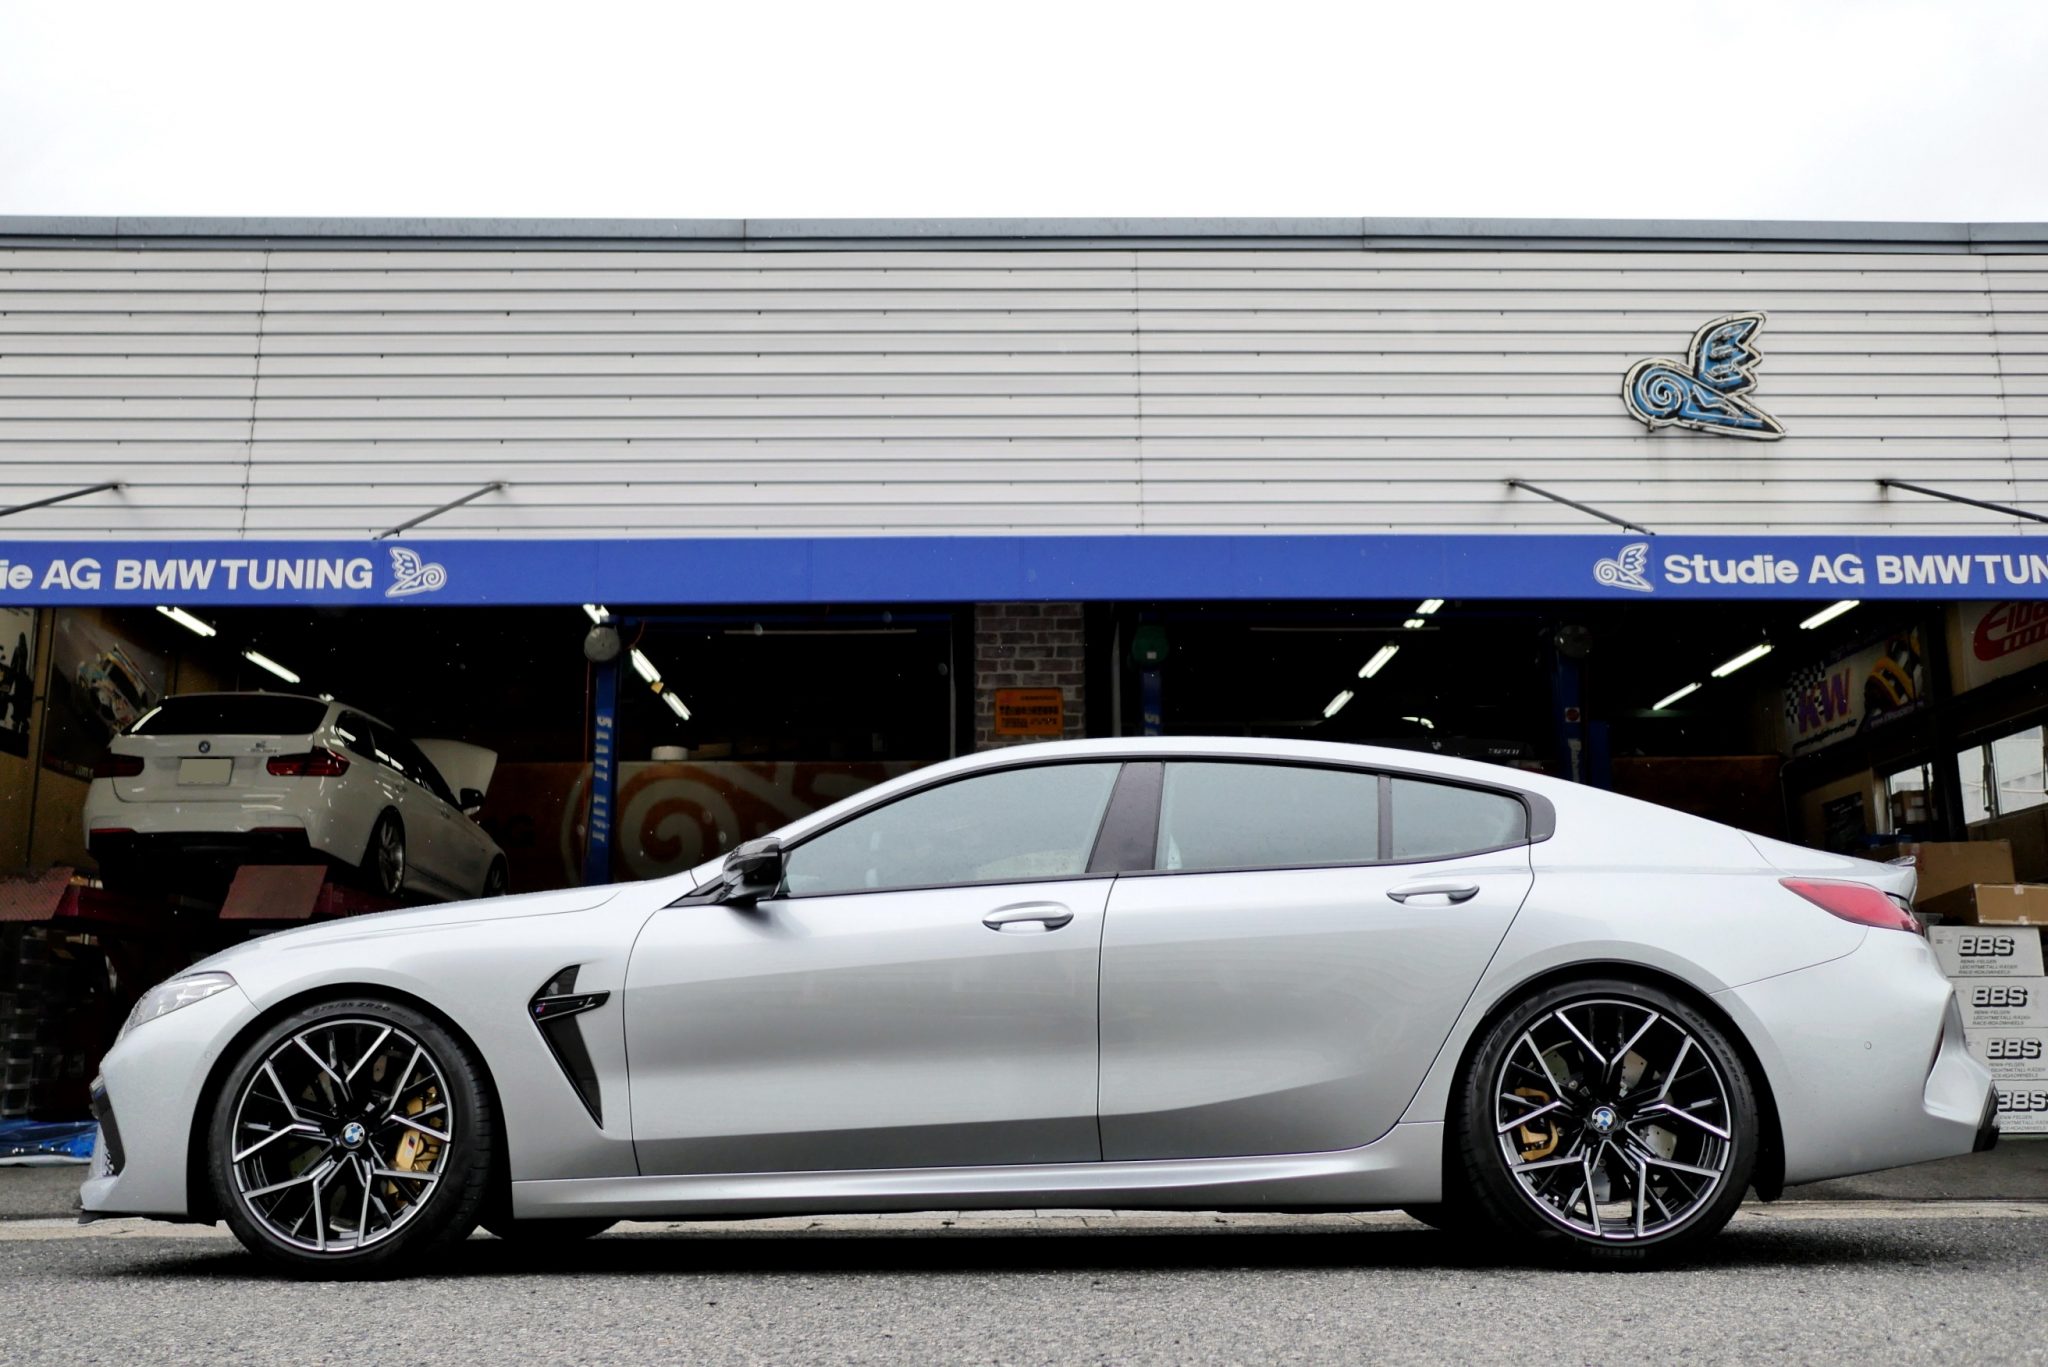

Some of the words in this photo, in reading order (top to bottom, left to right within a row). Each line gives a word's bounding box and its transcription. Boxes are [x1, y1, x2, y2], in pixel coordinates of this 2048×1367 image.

[41, 558, 101, 590] AG
[115, 559, 216, 590] BMW
[220, 558, 373, 590] TUNING
[1664, 554, 1800, 584] Studie
[1808, 553, 1865, 584] AG
[1876, 555, 1971, 584] BMW
[1974, 554, 2048, 584] TUN
[1958, 935, 2015, 957] BBS
[1972, 985, 2028, 1007] BBS
[1986, 1037, 2042, 1060] BBS
[1997, 1089, 2048, 1112] BBS
